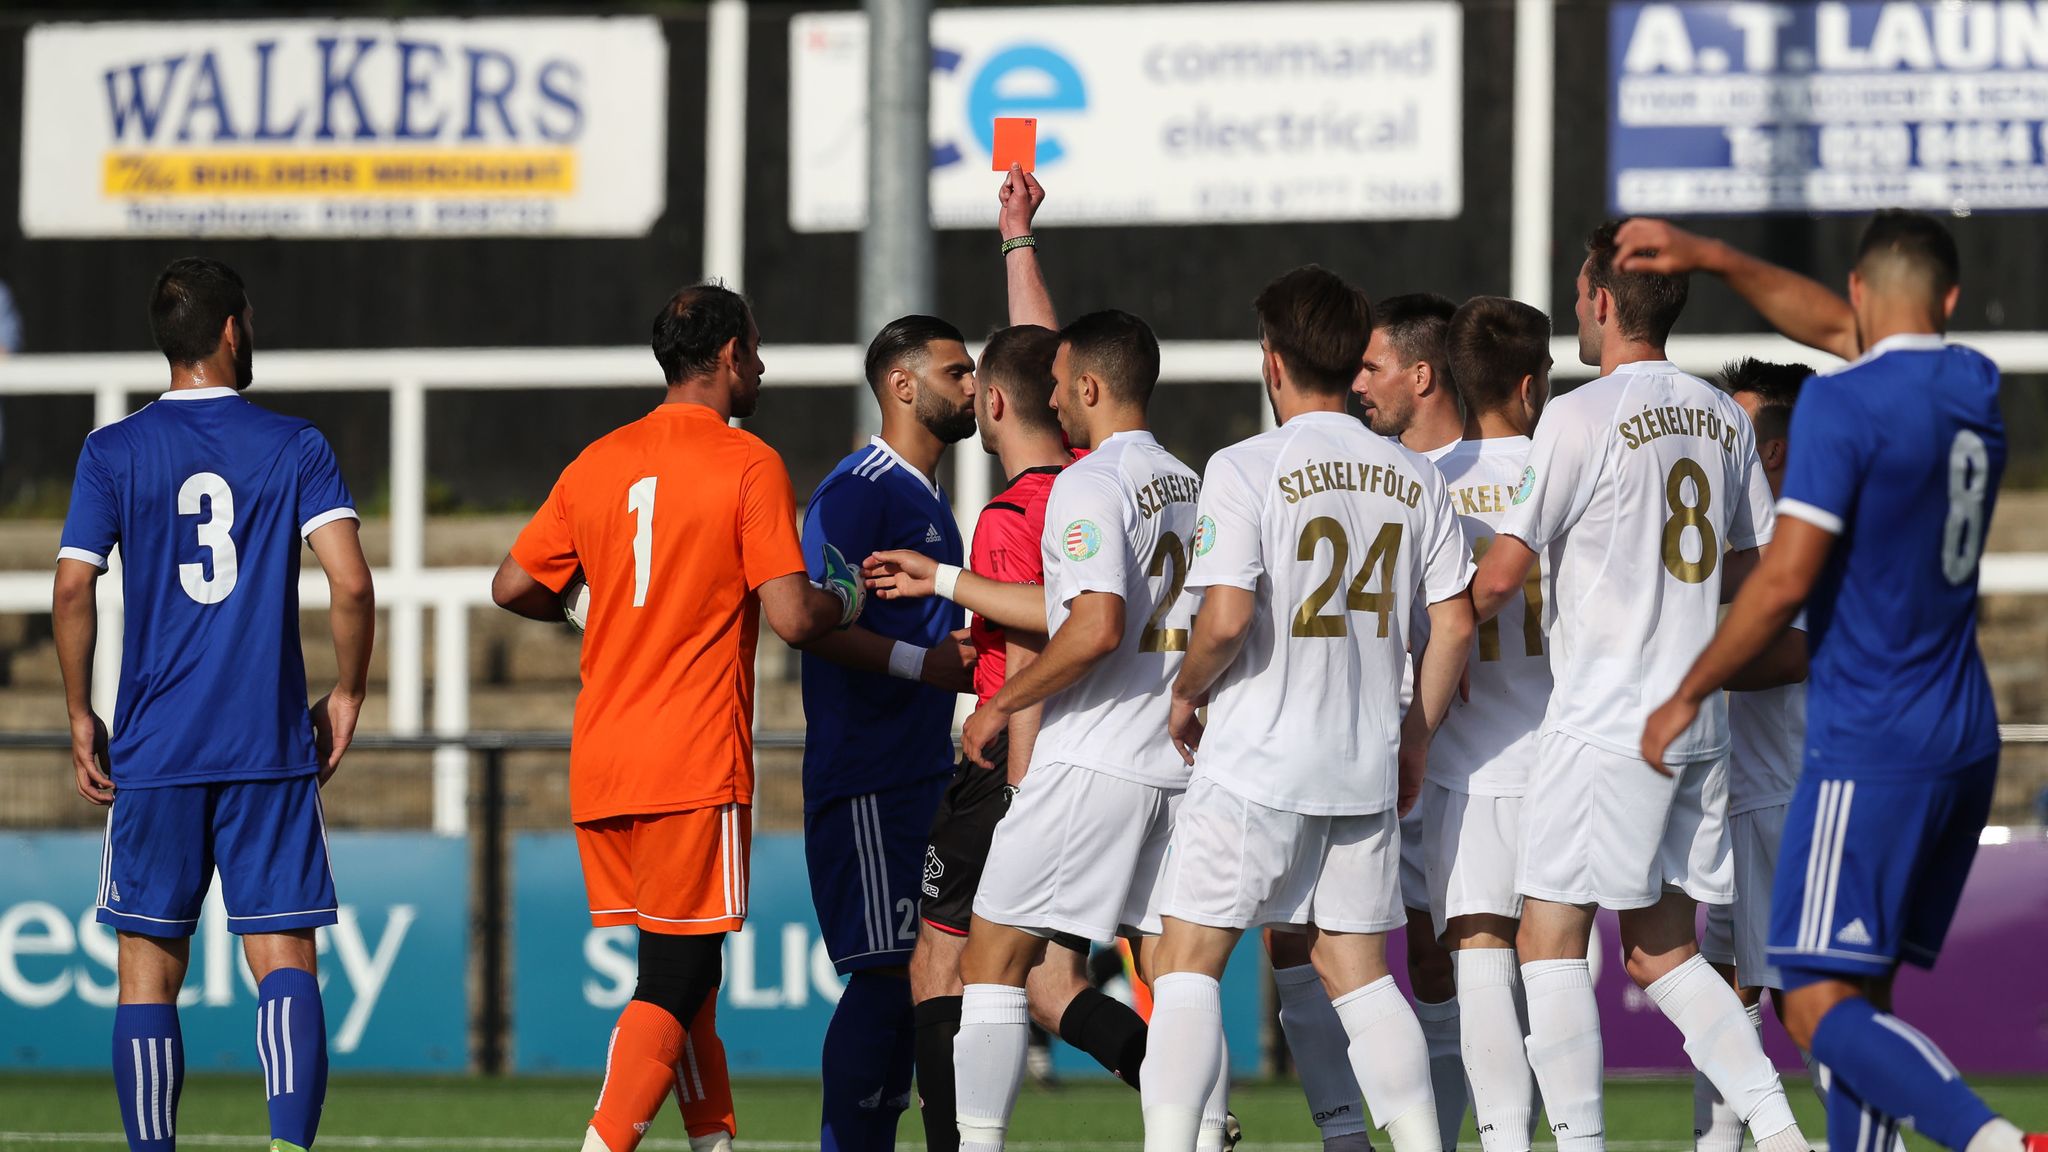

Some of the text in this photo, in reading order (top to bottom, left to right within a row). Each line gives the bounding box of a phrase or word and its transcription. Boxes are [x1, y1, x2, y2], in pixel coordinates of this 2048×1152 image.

[102, 36, 585, 142] WALKERS
[1145, 30, 1436, 81] command
[1160, 100, 1418, 154] electrical
[190, 161, 358, 185] BUILDERS
[371, 160, 563, 184] MERCHANT
[1619, 404, 1737, 453] SZÉKELYFÖLD
[1136, 474, 1201, 519] SZÉKELYF
[1279, 459, 1423, 509] SZÉKELYFÖLD
[1661, 457, 1718, 584] 8
[1942, 429, 1989, 585] 8
[178, 472, 238, 604] 3
[628, 476, 657, 608] 1
[1292, 516, 1403, 638] 24
[1138, 531, 1198, 653] 2
[896, 898, 922, 940] 2
[583, 921, 848, 1009] SLIC
